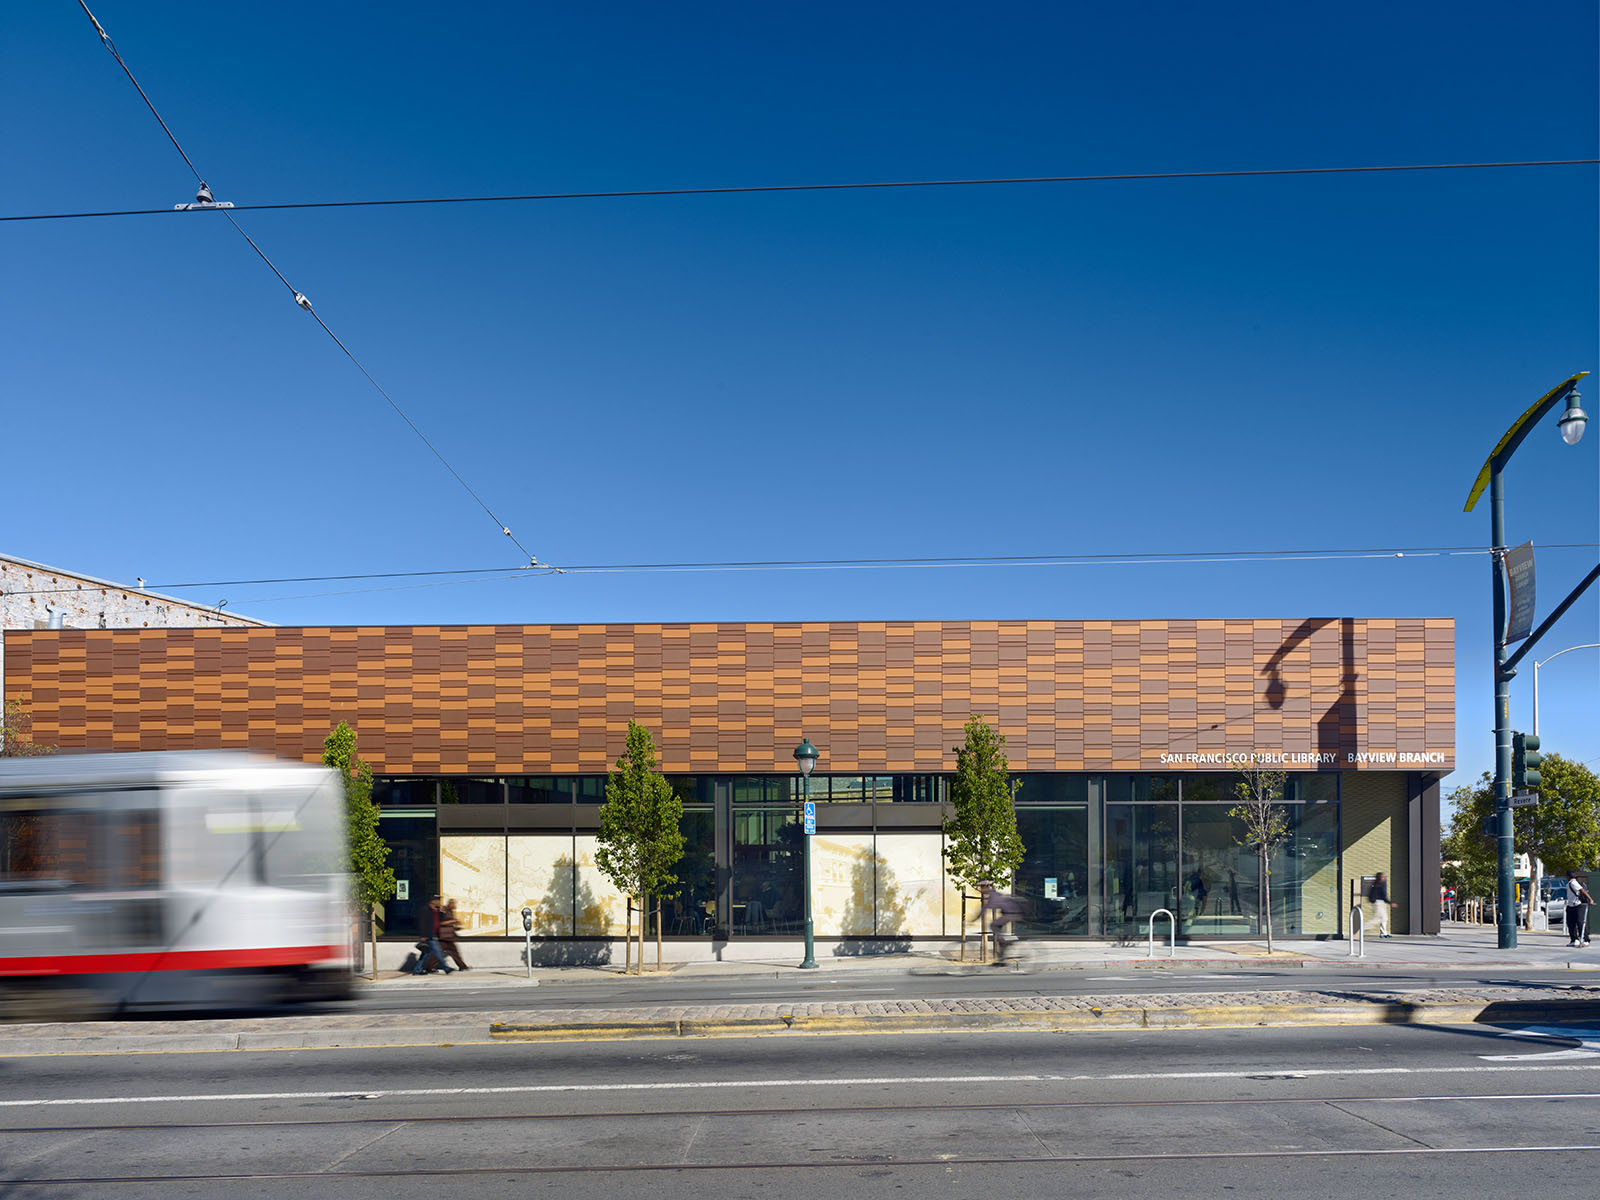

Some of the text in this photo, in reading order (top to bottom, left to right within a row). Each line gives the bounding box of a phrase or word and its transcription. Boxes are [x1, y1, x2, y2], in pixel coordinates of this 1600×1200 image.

[1160, 752, 1445, 763] SAN FRANCISCO PUBLIC LIBRARY BAYVIEW BRANCH
